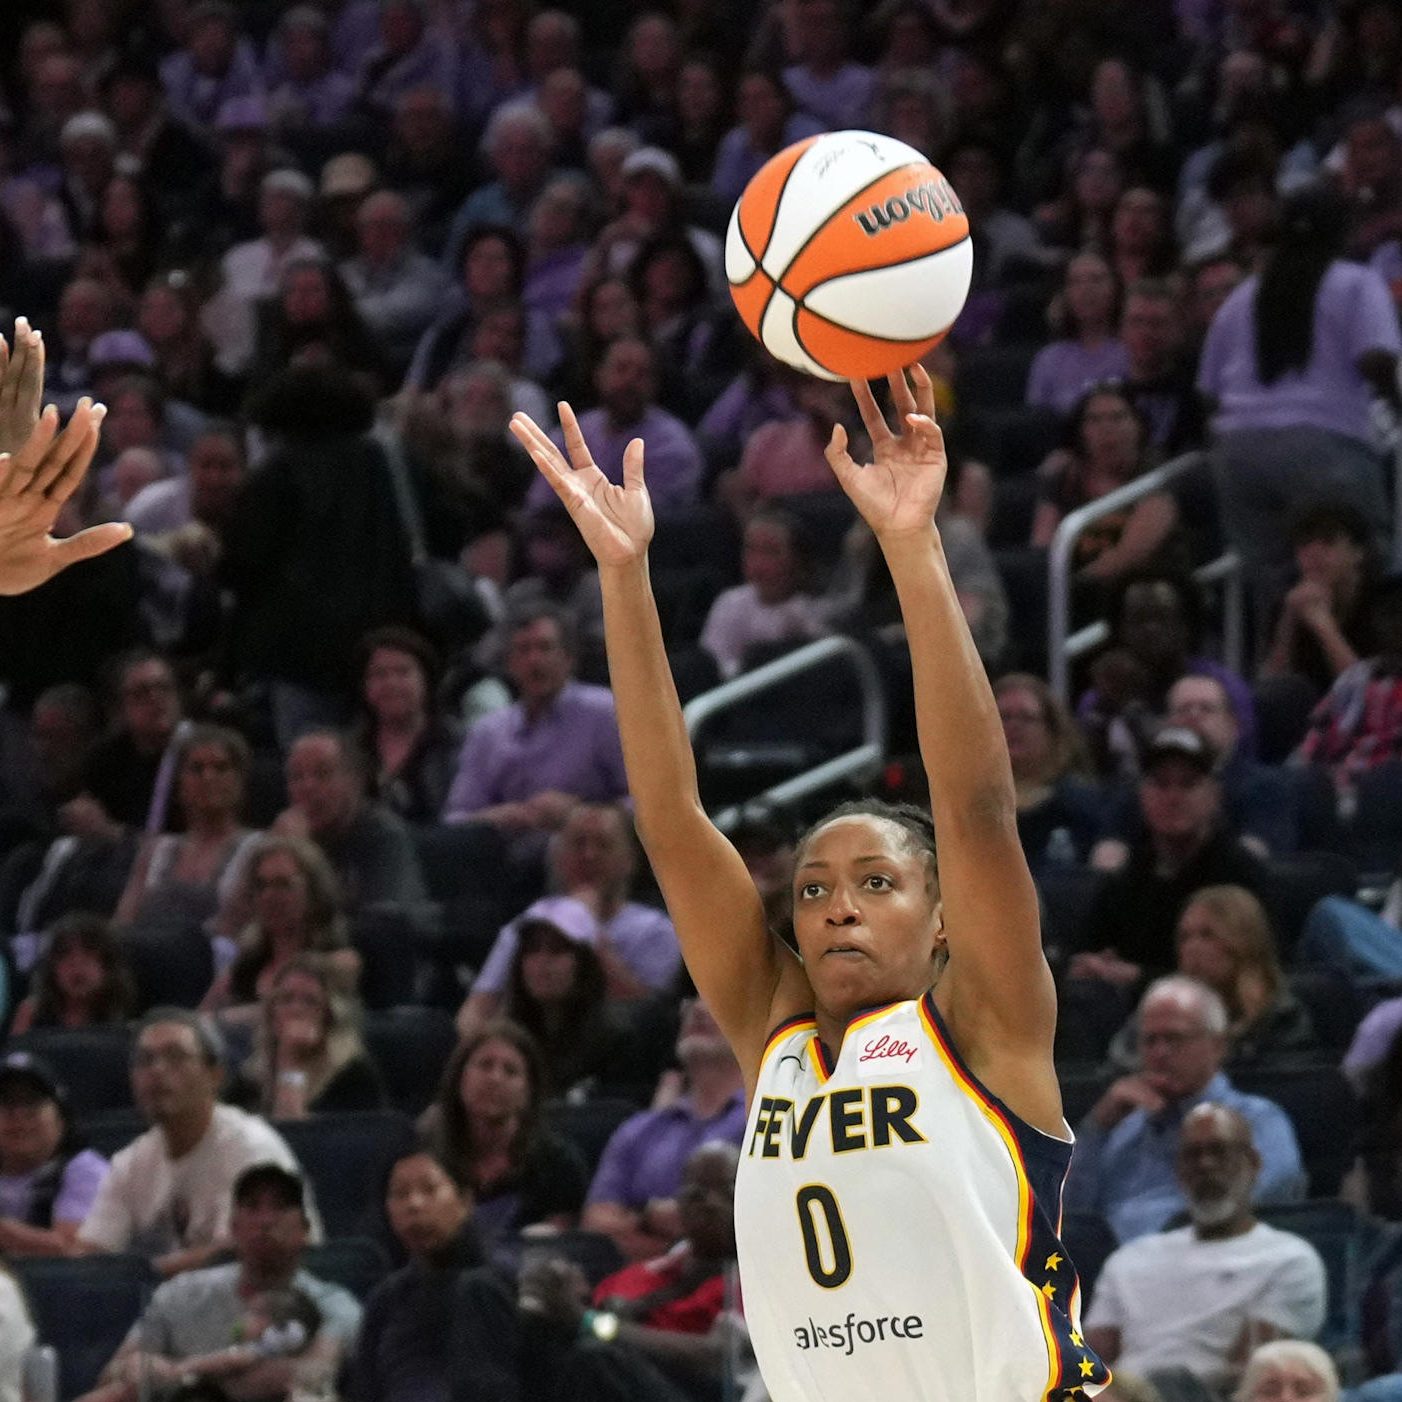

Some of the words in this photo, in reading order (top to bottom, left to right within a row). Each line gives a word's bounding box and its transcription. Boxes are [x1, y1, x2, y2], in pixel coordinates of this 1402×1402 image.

[859, 1034, 919, 1064] Lilly
[749, 1083, 930, 1162] FEVER
[795, 1182, 855, 1291] 0
[794, 1313, 923, 1356] alesforce
